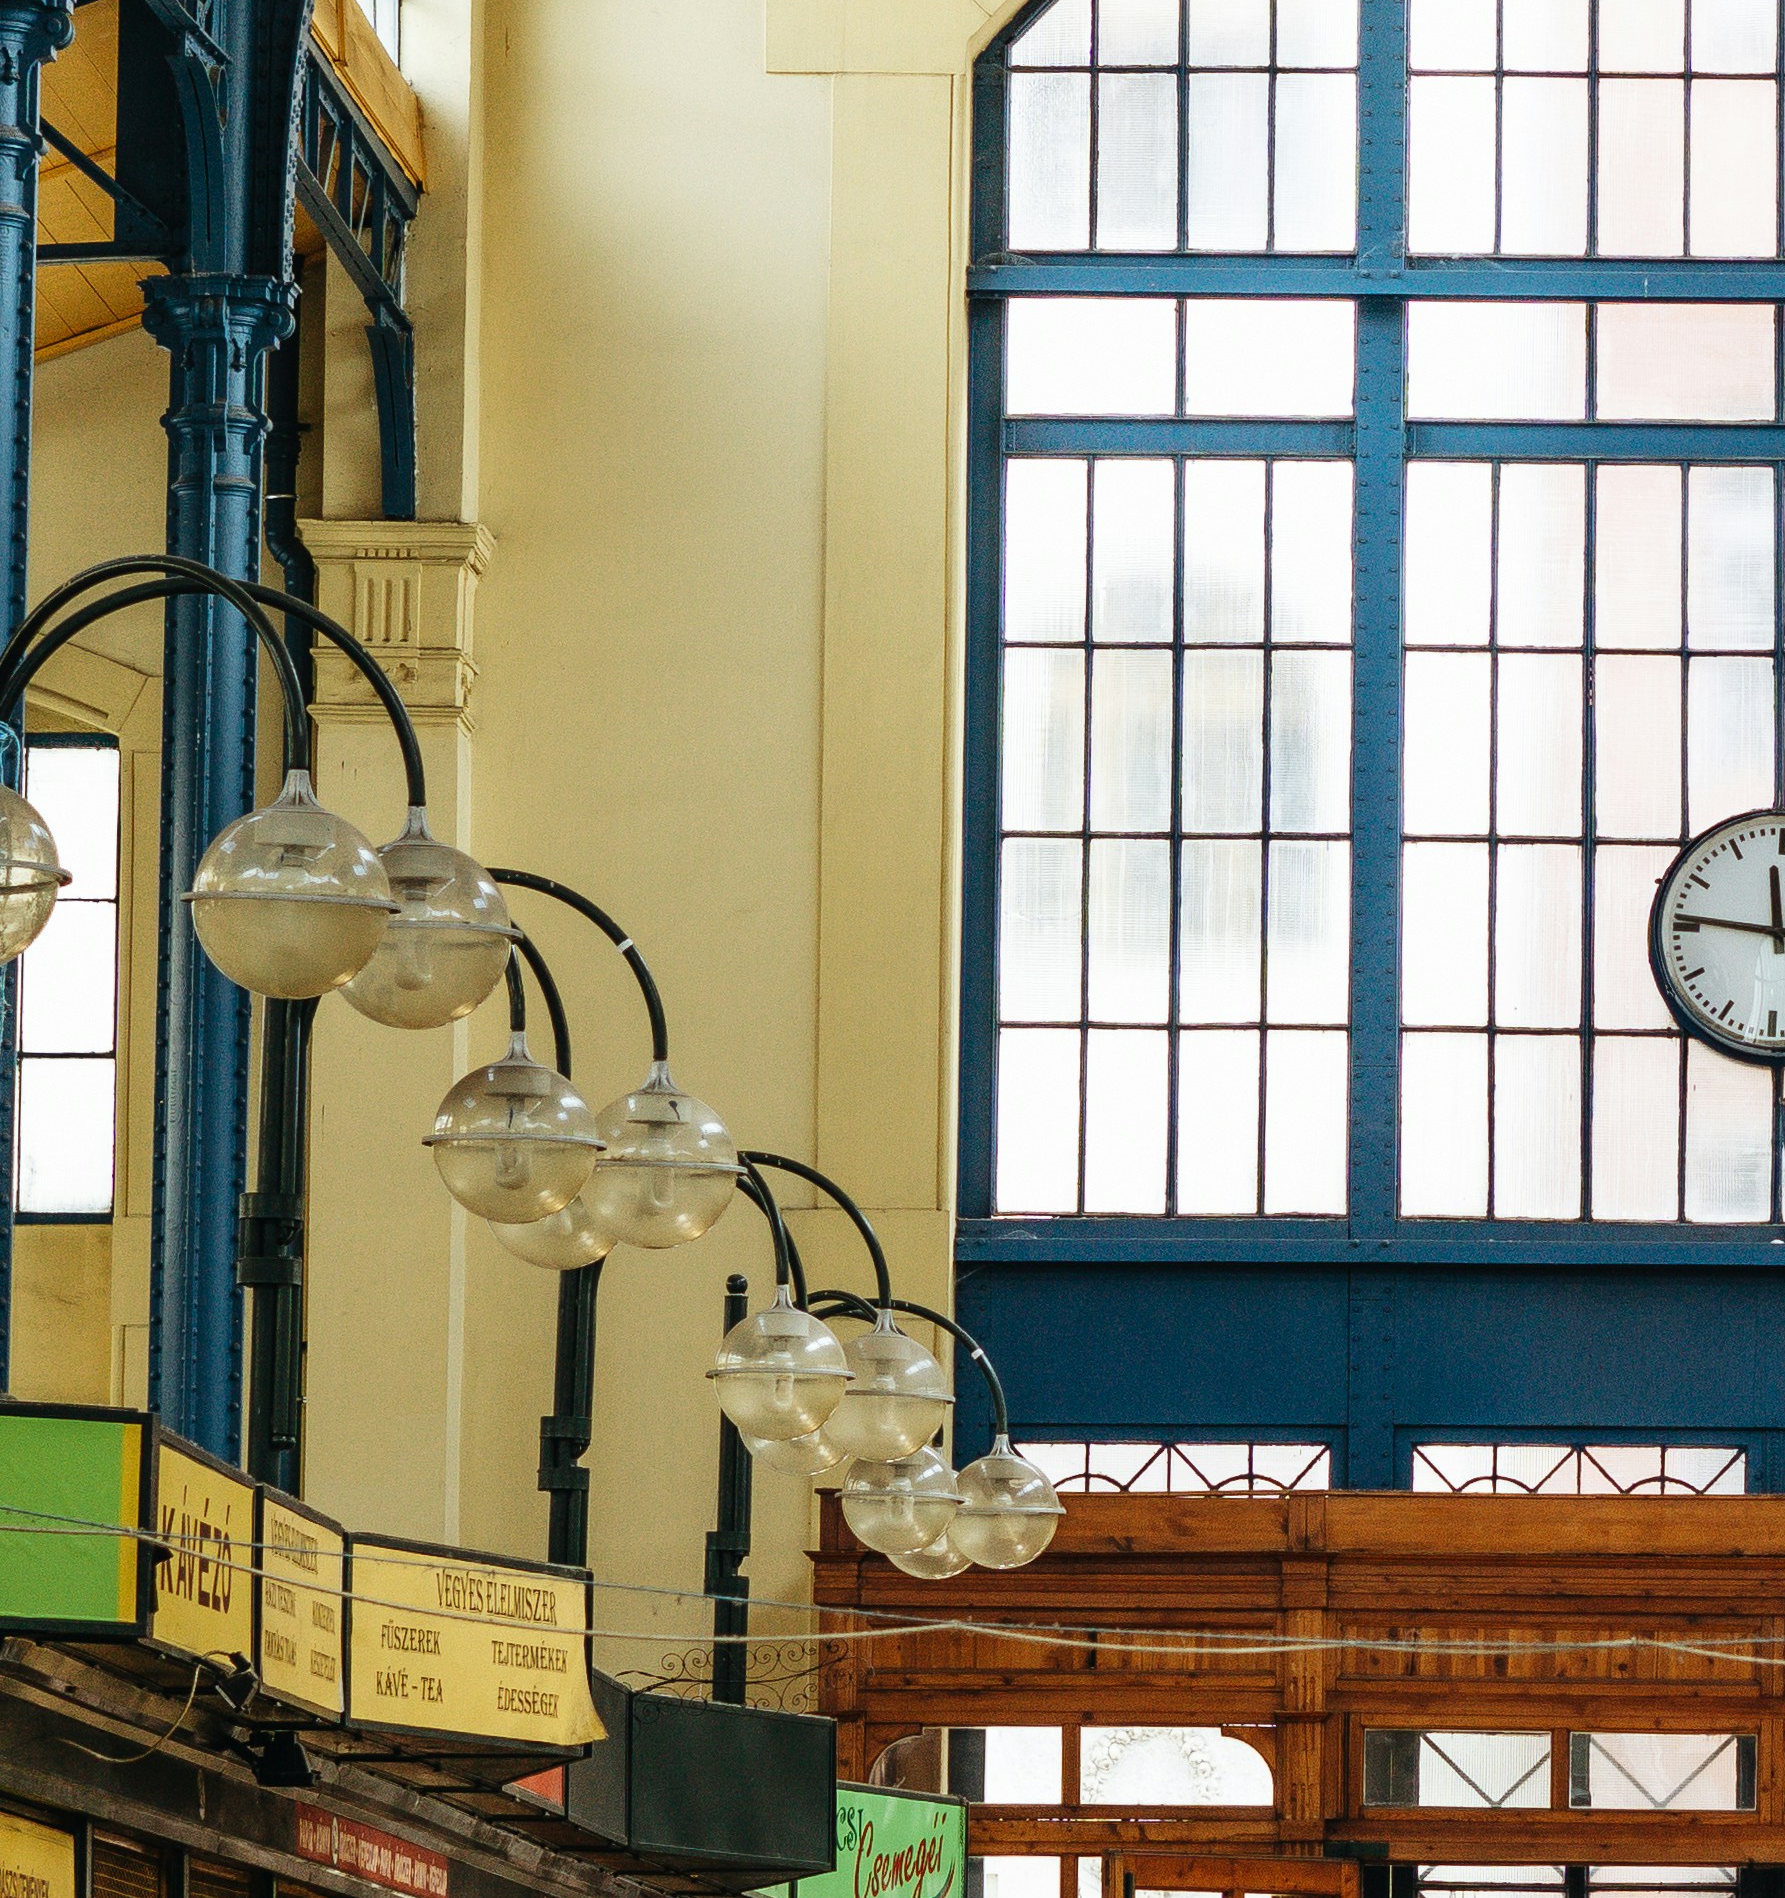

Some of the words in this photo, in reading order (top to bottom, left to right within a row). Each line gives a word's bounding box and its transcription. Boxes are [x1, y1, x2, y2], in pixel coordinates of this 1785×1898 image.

[160, 1485, 231, 1614] KÁVÉZÓ
[436, 1570, 484, 1613] VEGYES
[486, 1570, 558, 1625] ÉLELMISZER
[491, 1640, 568, 1673] TEJTERMÉKEK
[376, 1665, 409, 1699] KÁVÉ
[421, 1676, 443, 1702] TEA
[497, 1681, 559, 1718] ÉDESSÉGEK
